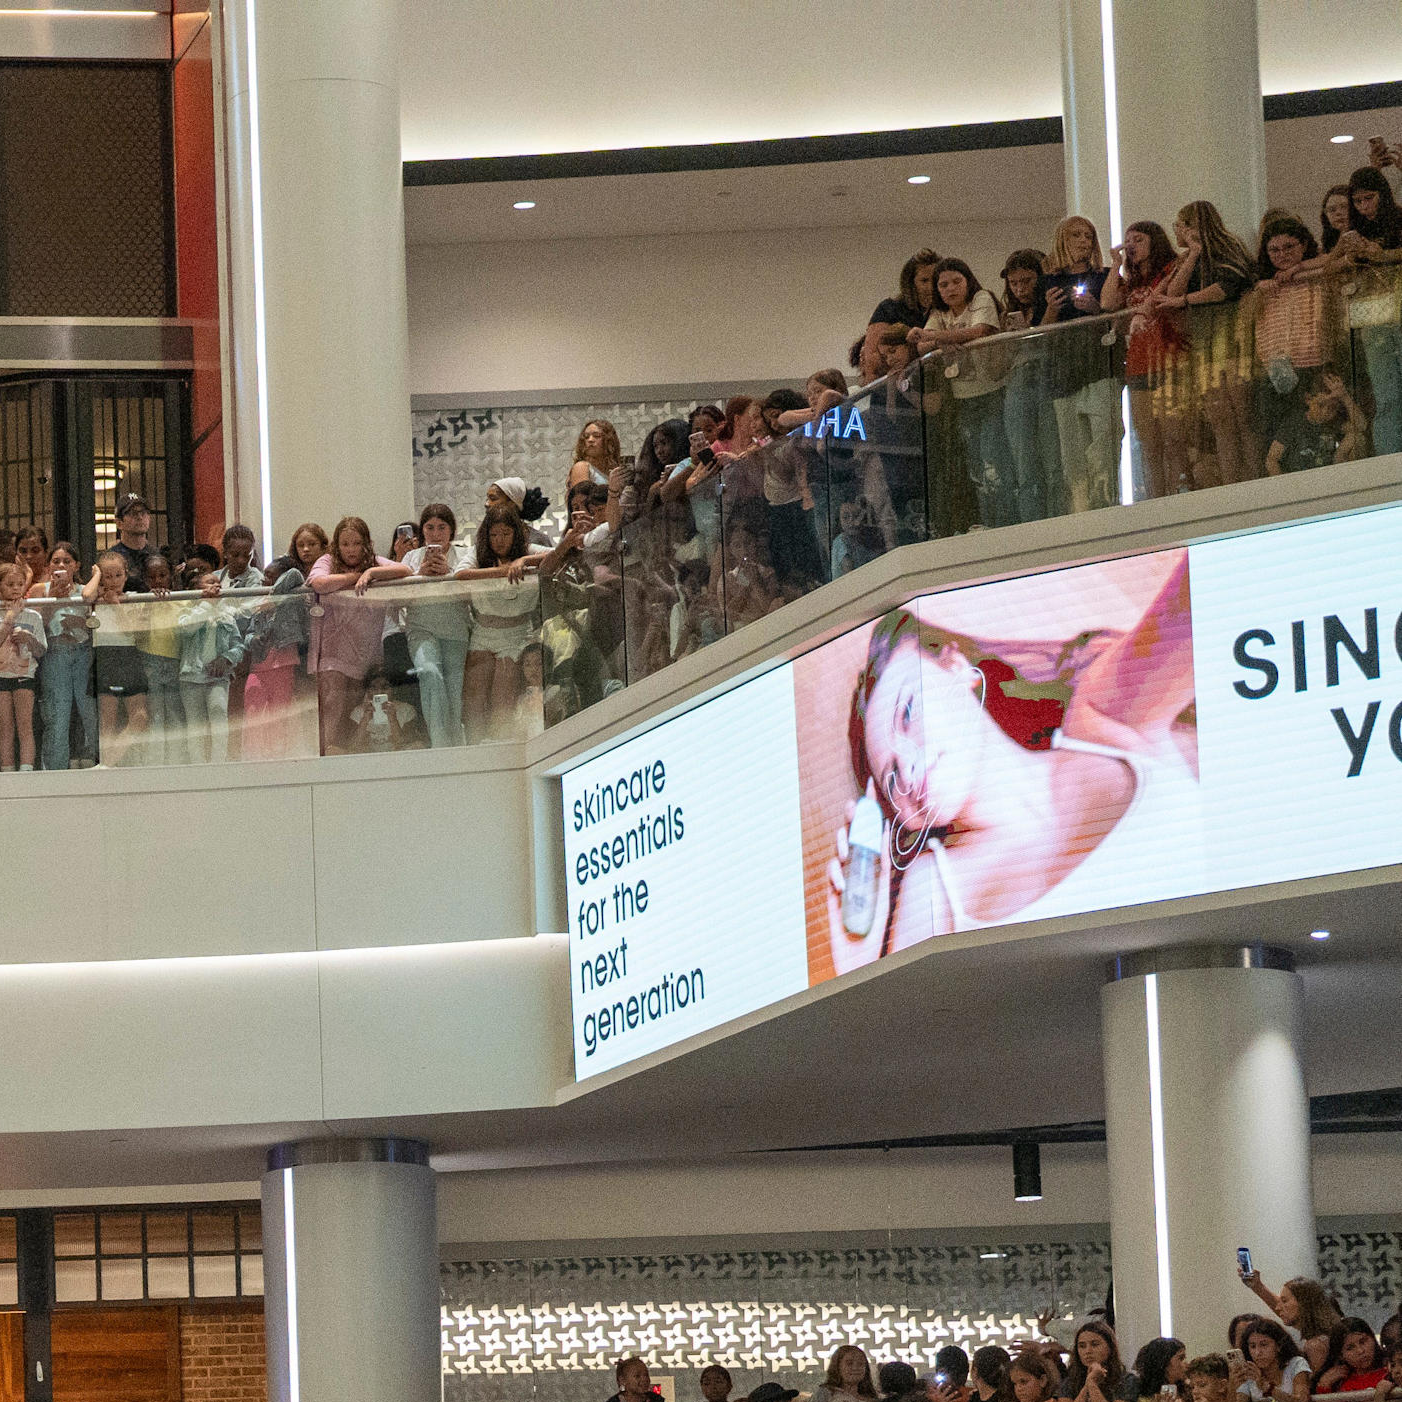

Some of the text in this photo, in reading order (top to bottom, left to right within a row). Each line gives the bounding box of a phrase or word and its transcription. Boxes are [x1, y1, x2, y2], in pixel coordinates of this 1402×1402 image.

[1232, 606, 1402, 700] SIN
[1330, 699, 1402, 778] Y
[573, 760, 666, 832] skincare
[576, 804, 685, 886] essentials
[577, 879, 649, 940] for the
[581, 937, 628, 994] next
[583, 967, 705, 1057] generation
